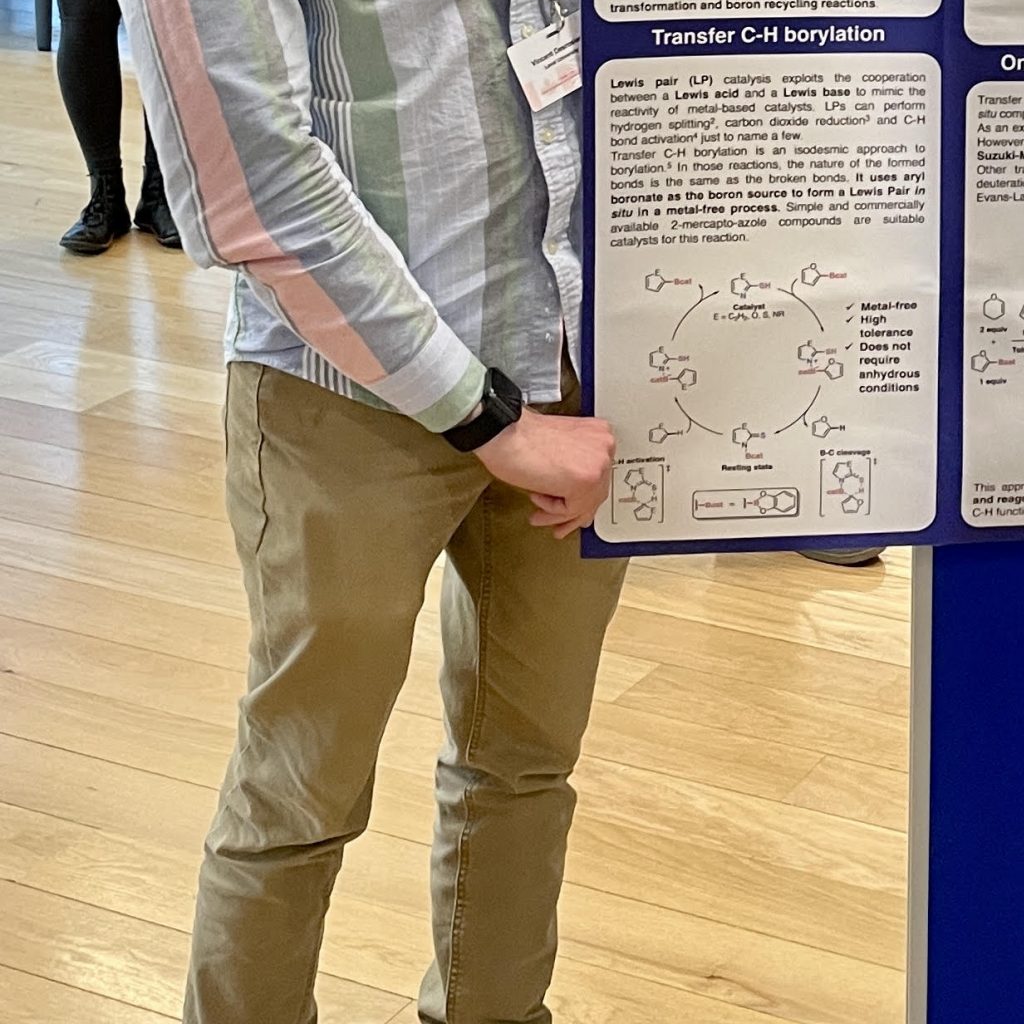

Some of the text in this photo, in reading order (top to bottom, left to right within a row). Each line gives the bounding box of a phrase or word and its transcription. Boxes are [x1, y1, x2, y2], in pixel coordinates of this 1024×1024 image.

[651, 25, 888, 46] Transfer C-H borylation
[609, 73, 927, 90] Lewis pair (LP) catalysis exploits the cooperation
[977, 94, 1023, 105] Transfer
[861, 301, 918, 311] Metal-free
[860, 314, 887, 326] High
[859, 328, 914, 338] tolerance
[859, 341, 911, 352] Does not
[859, 356, 901, 366] require
[859, 369, 921, 381] anhydrous
[858, 383, 920, 393] conditions
[973, 482, 996, 492] This
